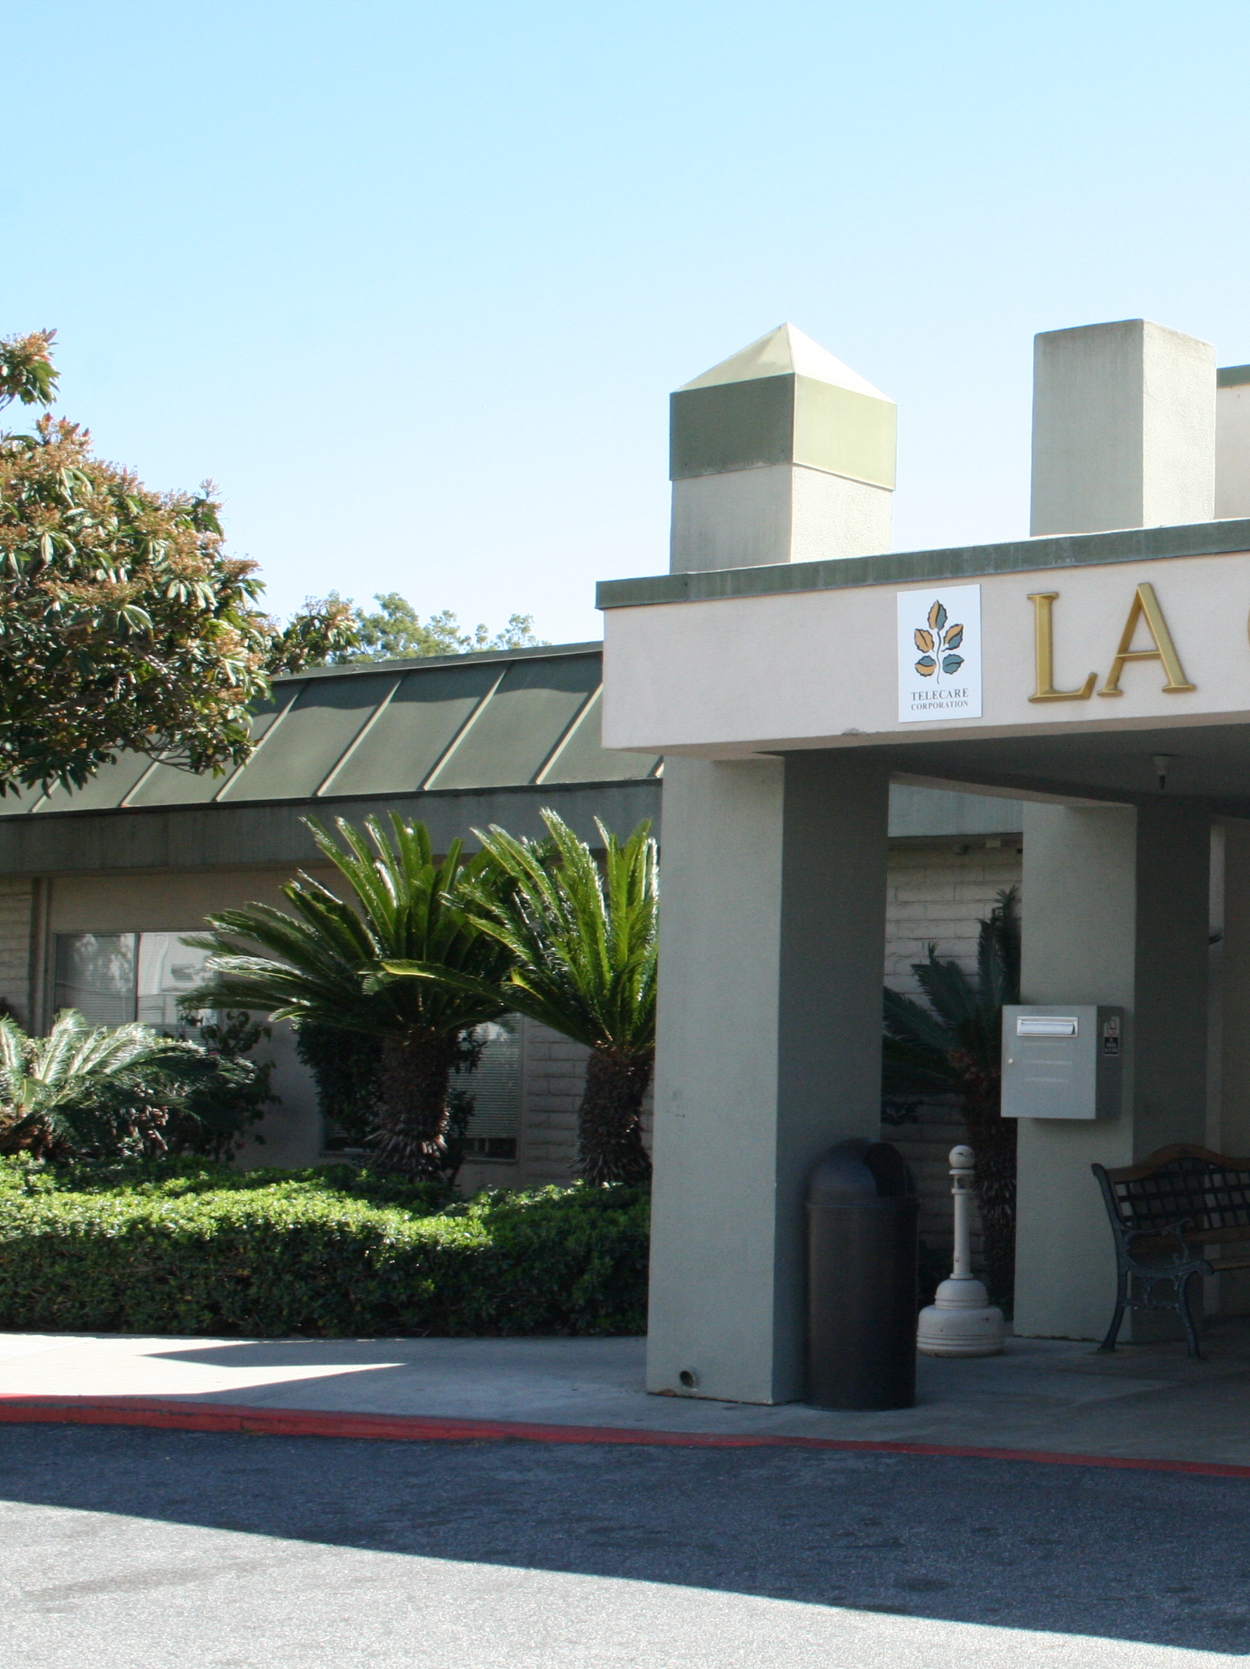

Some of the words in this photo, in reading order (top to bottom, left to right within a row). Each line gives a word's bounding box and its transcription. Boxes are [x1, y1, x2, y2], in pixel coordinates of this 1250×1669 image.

[1027, 582, 1196, 703] LA
[911, 688, 968, 701] TELECARE
[911, 700, 968, 711] CORPORATION
